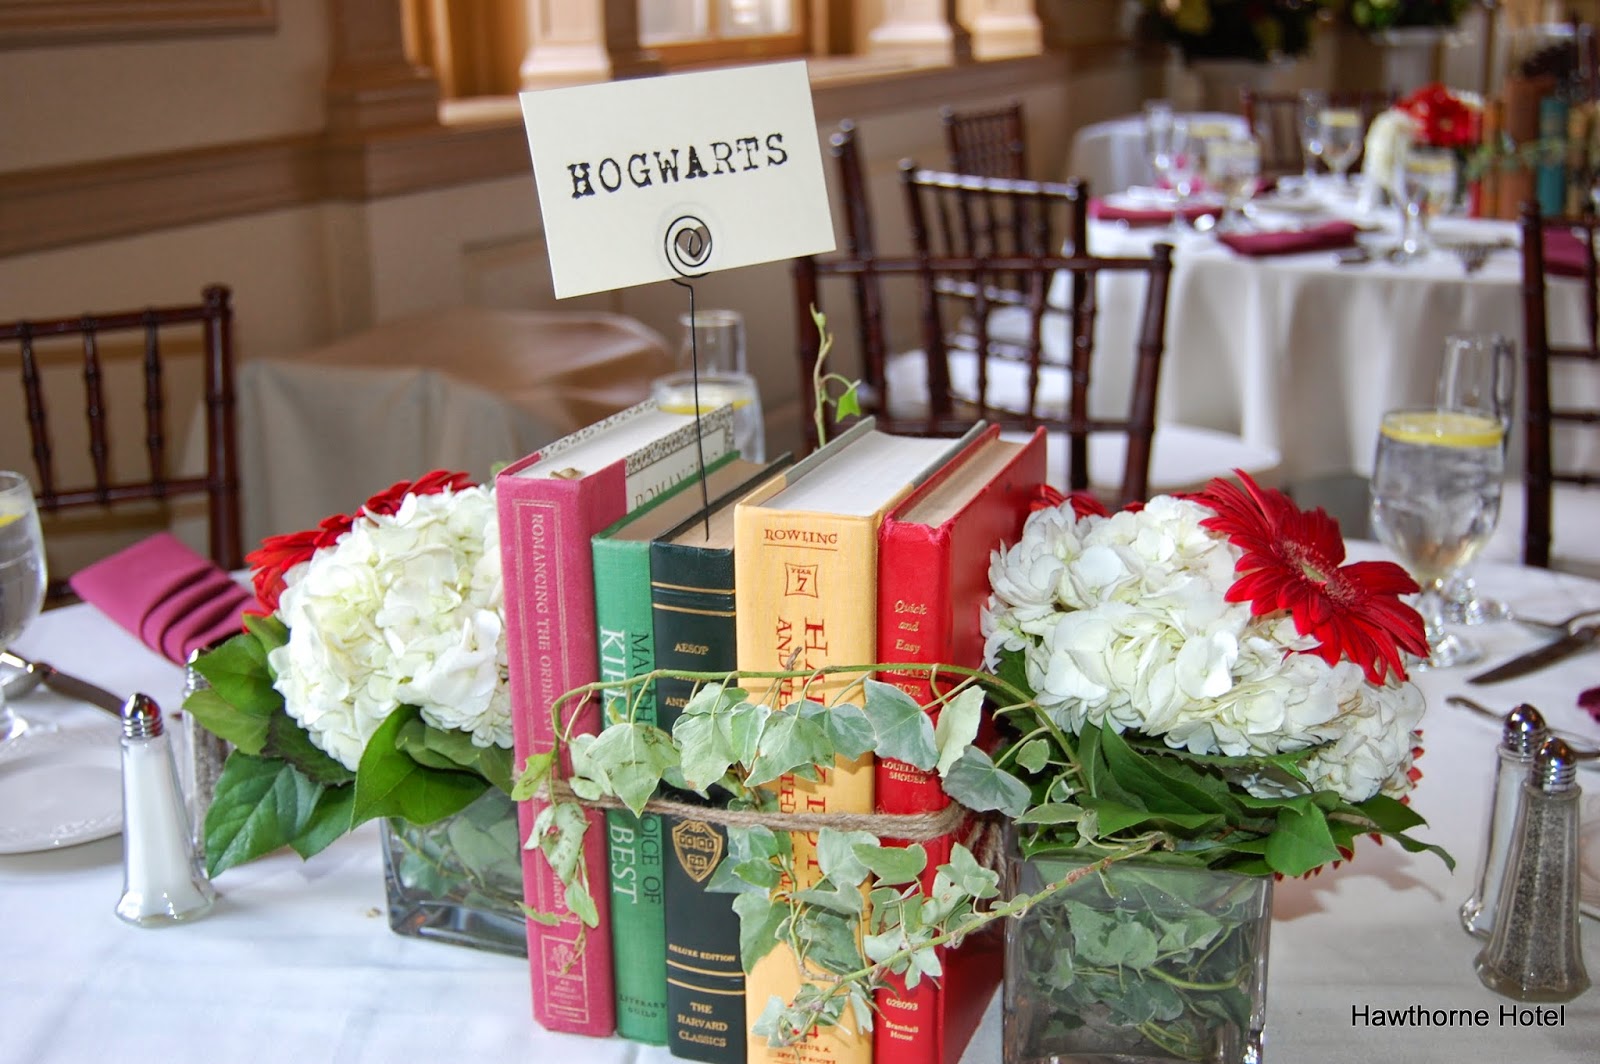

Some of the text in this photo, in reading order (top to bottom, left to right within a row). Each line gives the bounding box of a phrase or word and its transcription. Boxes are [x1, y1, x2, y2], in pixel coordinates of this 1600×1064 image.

[567, 133, 788, 199] HOGWARTS
[764, 528, 838, 545] ROWLING
[532, 513, 549, 614] ROMANCING
[795, 574, 808, 592] 7
[895, 599, 927, 616] Quick
[536, 618, 551, 651] THE
[898, 621, 920, 633] and
[673, 643, 710, 656] AESOP
[895, 639, 921, 655] Easy
[610, 822, 638, 905] BEST
[643, 876, 661, 905] OF
[668, 943, 736, 963] DELUXE EDITION
[619, 994, 667, 1009] LITERARY
[690, 1001, 713, 1014] THE
[628, 1006, 657, 1018] GUILD
[677, 1013, 728, 1032] HARVARD
[678, 1030, 727, 1048] CLASSICS
